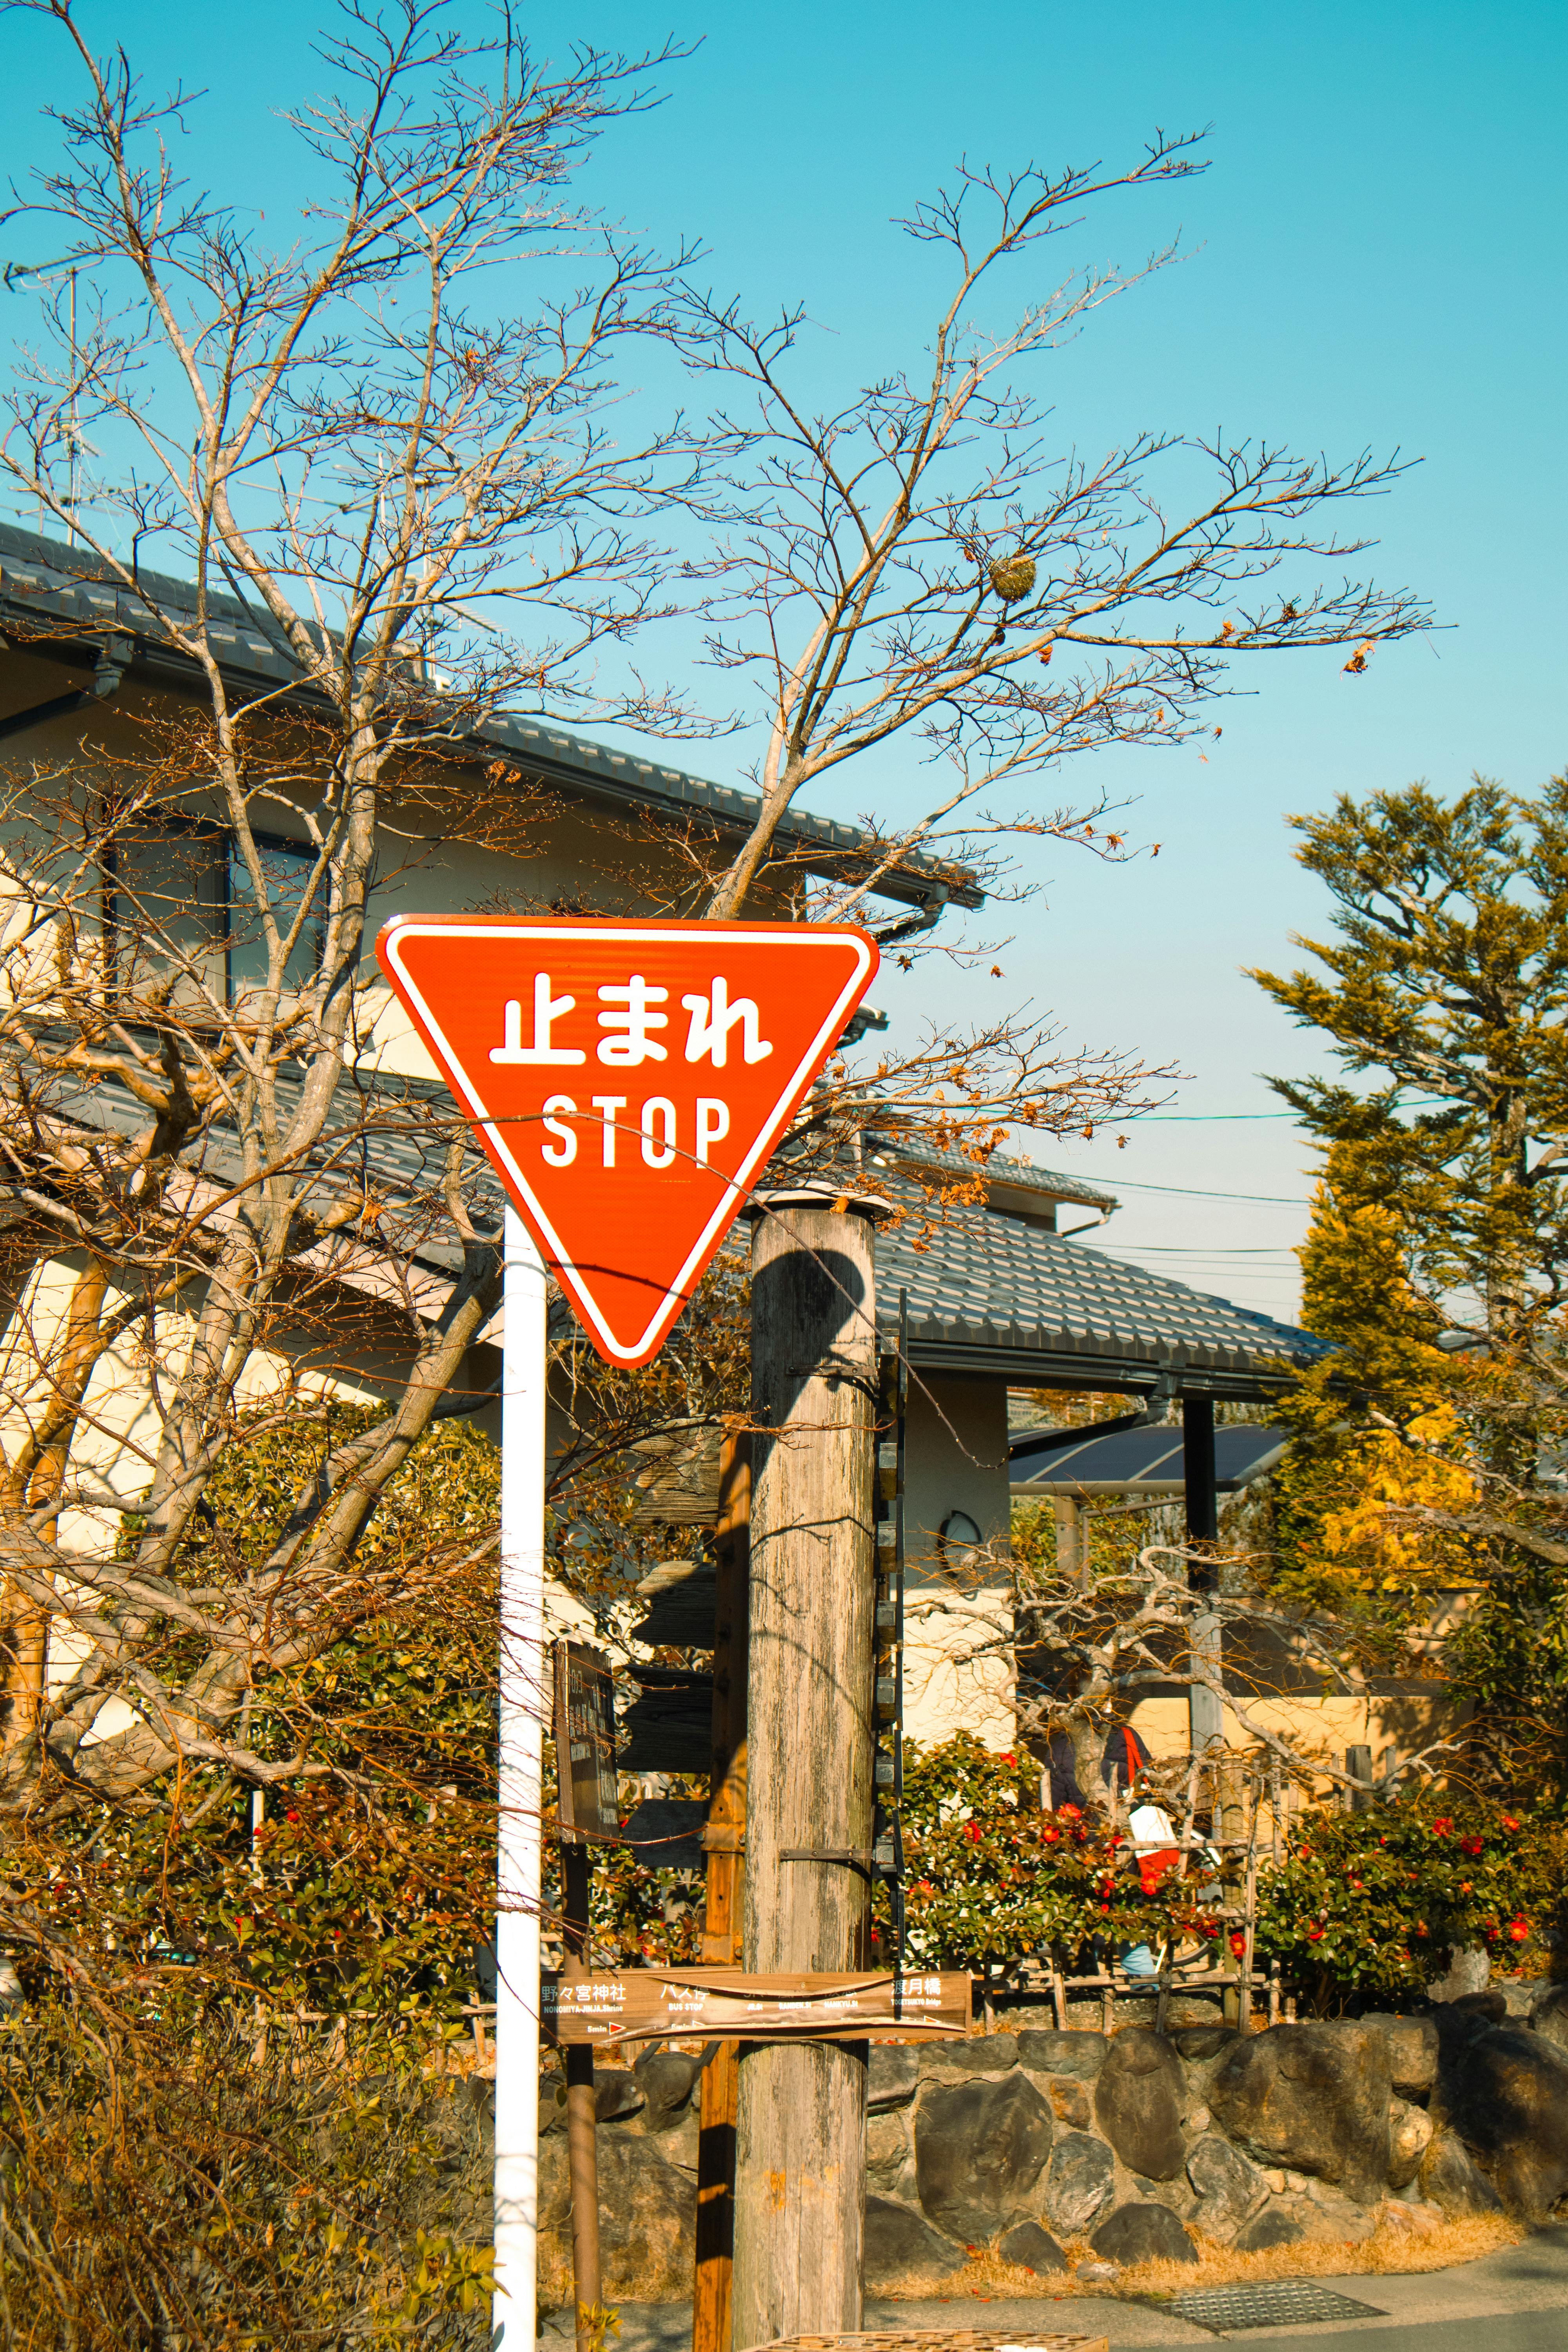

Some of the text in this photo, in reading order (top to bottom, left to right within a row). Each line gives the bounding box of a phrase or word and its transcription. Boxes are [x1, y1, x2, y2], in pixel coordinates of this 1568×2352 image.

[489, 972, 773, 1068] 止まれ
[541, 1095, 730, 1169] STOP
[542, 1984, 627, 2002] 野々宮神社
[661, 1984, 710, 2000] バス停
[891, 1978, 941, 1995] 渡月橋
[926, 1998, 942, 2007] Bridge
